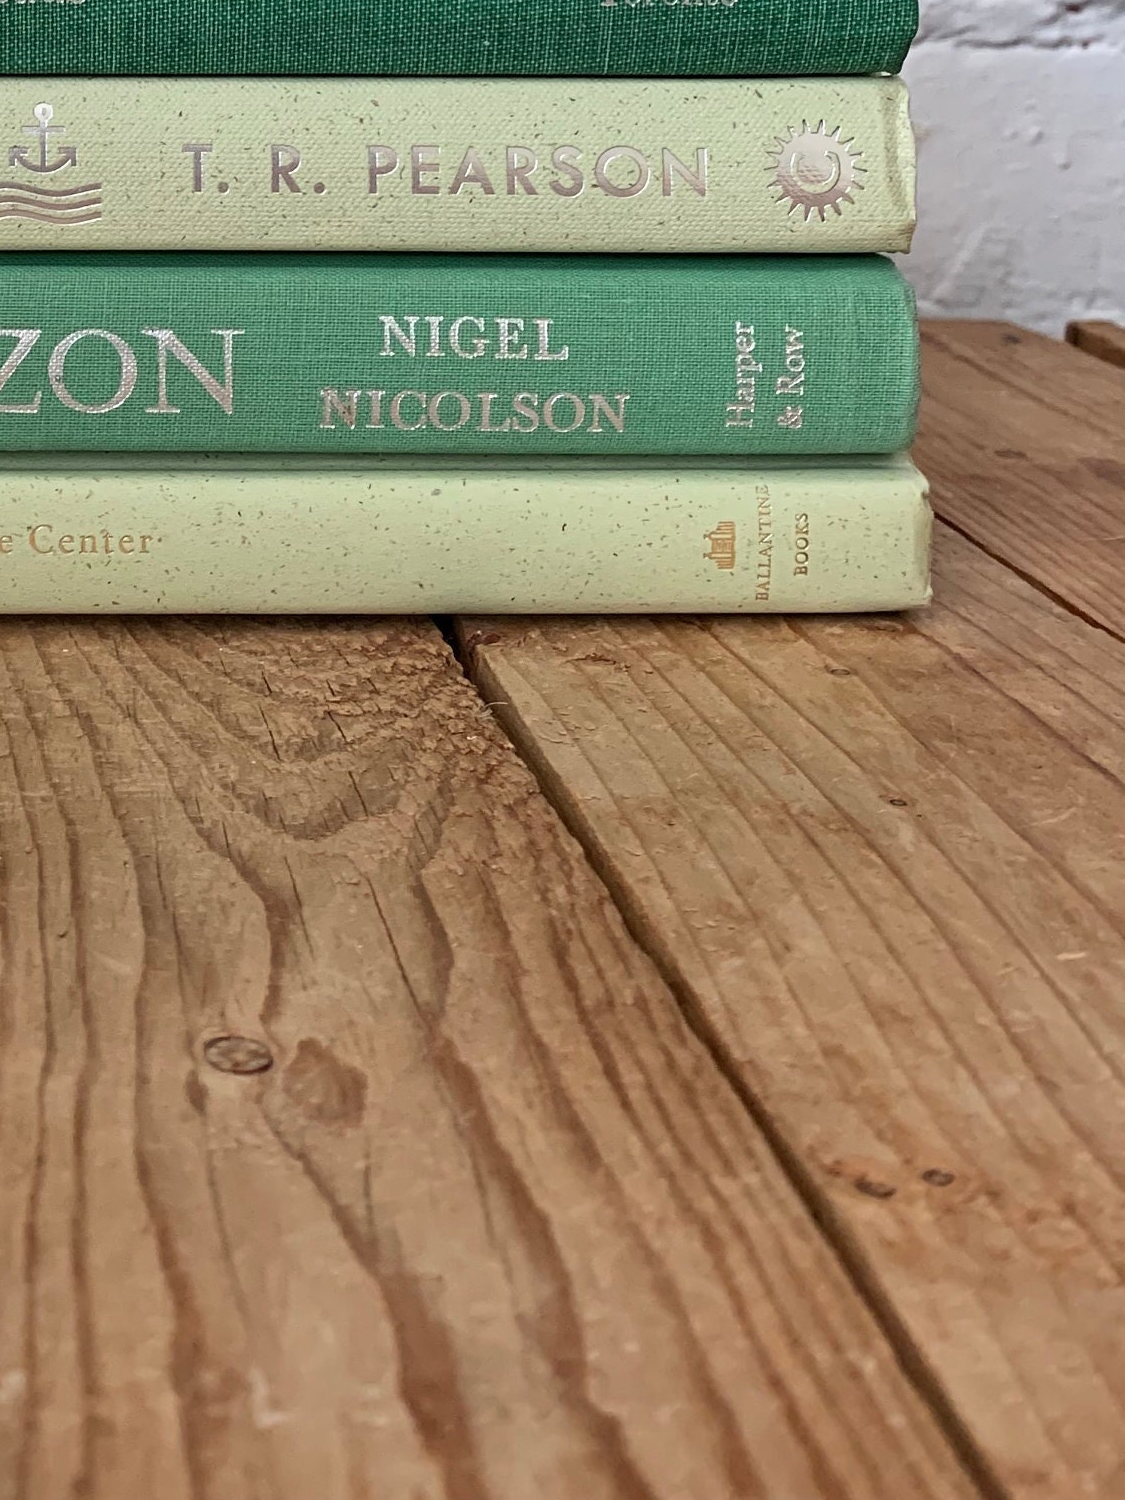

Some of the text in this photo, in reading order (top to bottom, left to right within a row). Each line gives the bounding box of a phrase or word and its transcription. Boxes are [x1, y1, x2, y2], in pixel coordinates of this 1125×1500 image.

[181, 144, 708, 198] T. R. PEARSON
[379, 315, 570, 360] NIGEL
[726, 321, 762, 429] Harper
[777, 326, 806, 430] & Row
[319, 387, 631, 434] NICOLSON
[27, 523, 155, 556] Center
[755, 484, 774, 601] BALLANTINE
[793, 512, 810, 577] BOOKS
